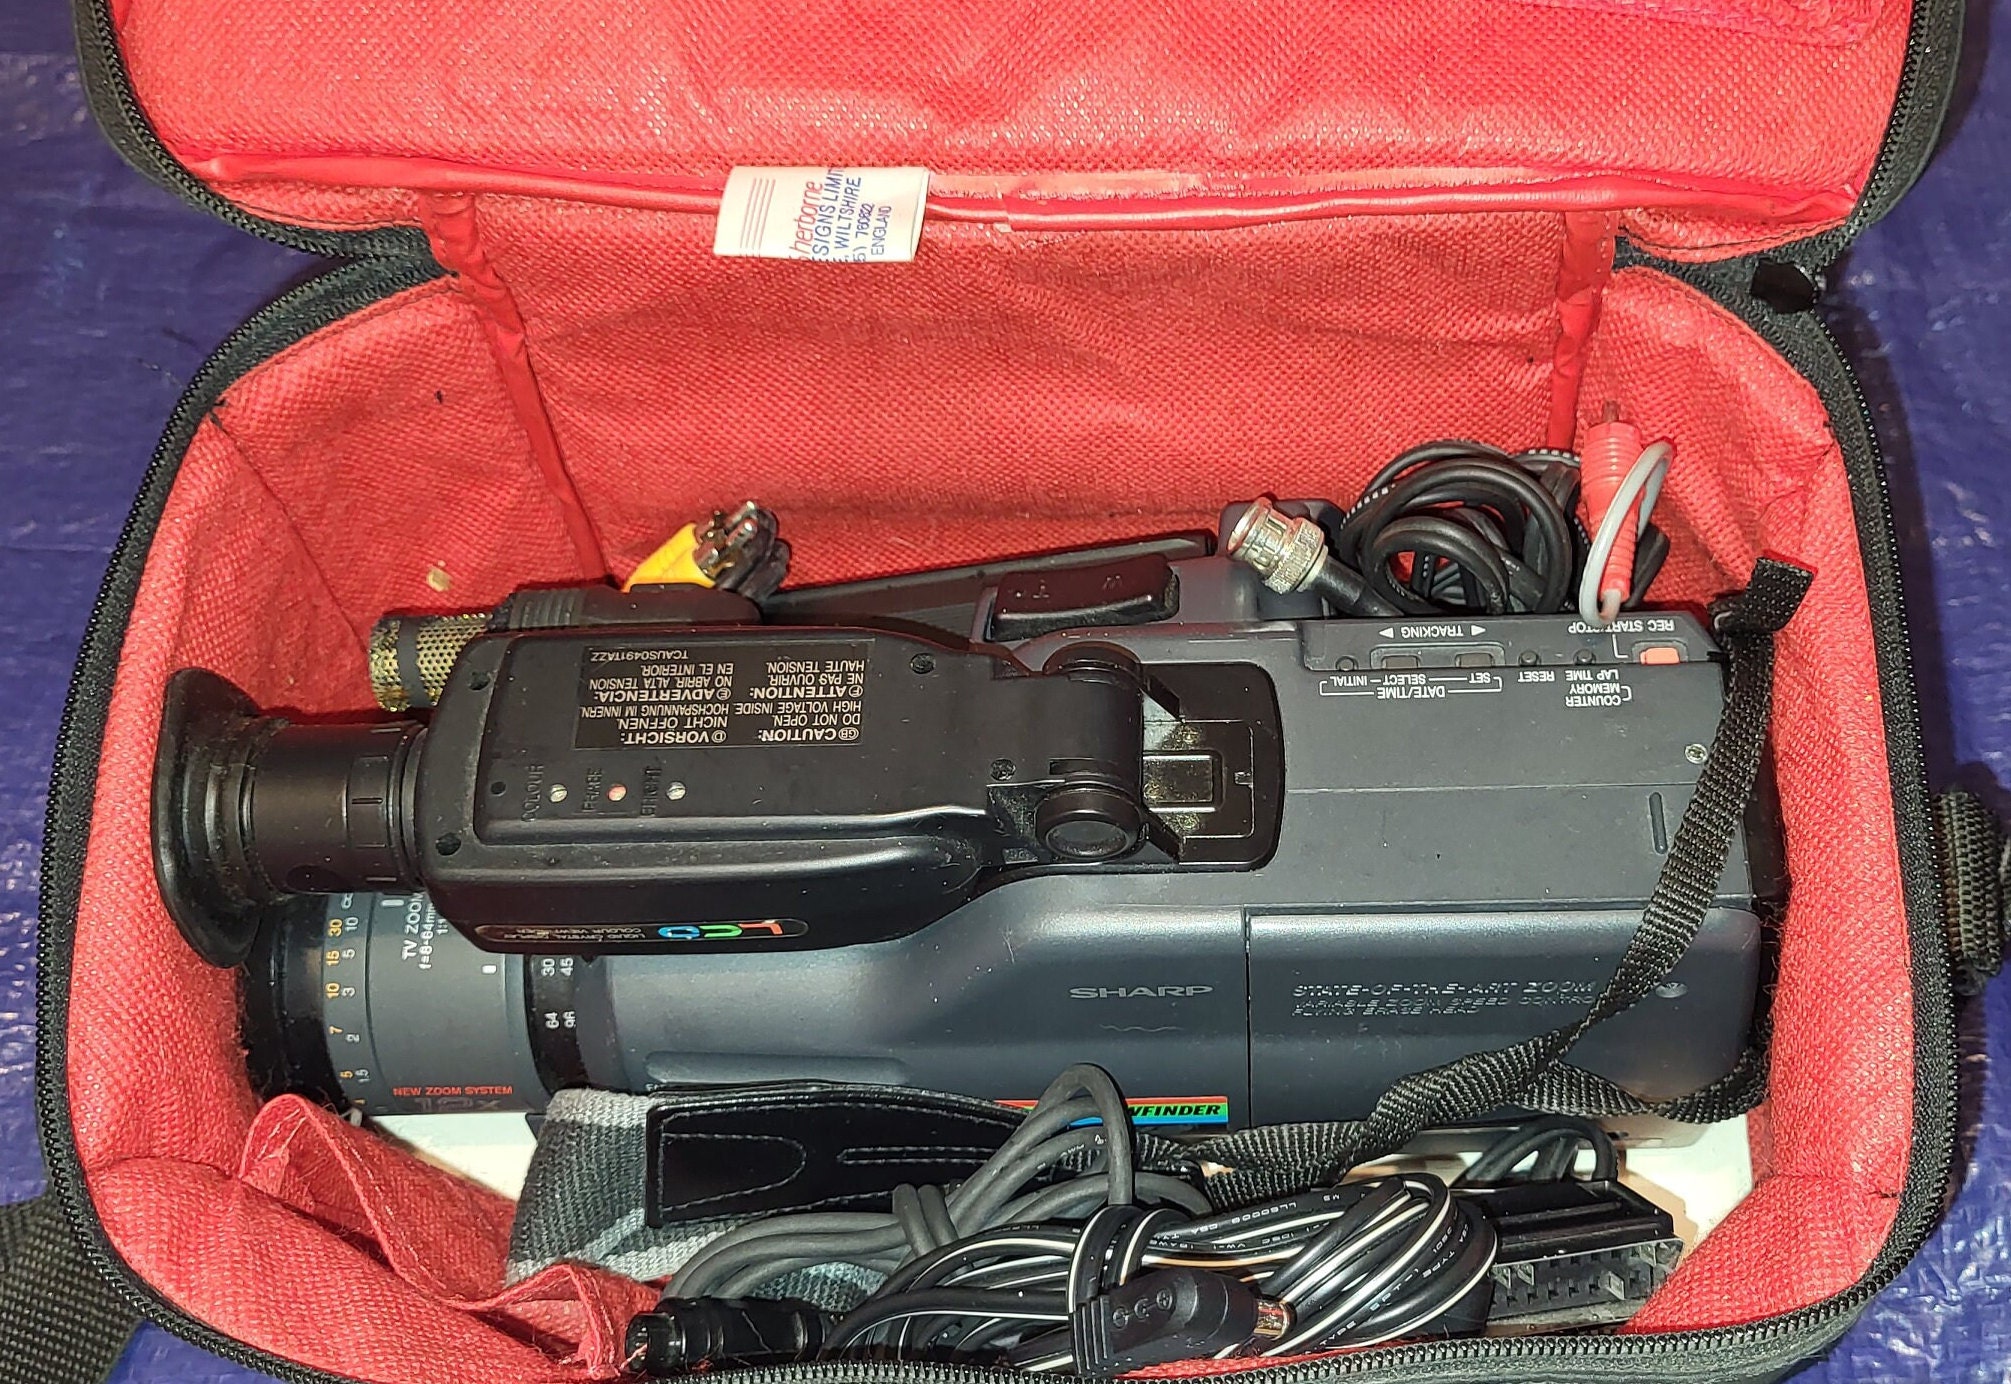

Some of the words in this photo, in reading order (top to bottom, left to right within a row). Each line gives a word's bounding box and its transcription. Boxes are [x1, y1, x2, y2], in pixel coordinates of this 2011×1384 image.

[834, 177, 861, 249] WILTSHIRE
[789, 181, 823, 261] herborne
[811, 206, 835, 263] SIGNS
[871, 206, 892, 255] ENGLAND
[1401, 624, 1463, 637] TRACKING
[1647, 619, 1674, 631] REC
[640, 664, 694, 676] INTERIOR.
[699, 663, 713, 674] EL
[718, 662, 734, 674] EN
[766, 661, 820, 672] TENSION.
[826, 660, 864, 672] HAUTE
[768, 674, 814, 685] OUVRIR.
[819, 673, 842, 684] PAS
[848, 672, 864, 683] NE
[1330, 675, 1367, 686] INITIAL
[1384, 674, 1426, 685] SELECT
[1469, 672, 1491, 683] SET
[1518, 671, 1554, 682] RESET
[1566, 670, 1592, 681] TIME
[1595, 669, 1619, 680] LAP
[589, 678, 638, 690] TENSION
[643, 677, 670, 688] ALTA
[675, 676, 710, 688] ABRIR.
[715, 676, 732, 687] NO
[594, 688, 714, 701] ADVERTENCIA:
[749, 686, 847, 698] ATTENTION:
[1377, 686, 1445, 698] DATE/TIME
[1570, 683, 1620, 694] MEMORY
[833, 700, 862, 712] HIGH
[1566, 695, 1621, 706] COUNTER
[580, 706, 622, 717] INNERN.
[625, 706, 637, 716] IM
[641, 703, 729, 716] HOCHSPANNUNG
[734, 702, 773, 714] INSIDE.
[778, 701, 828, 713] VOLTAGE
[684, 717, 728, 728] NICHT
[772, 714, 808, 726] OPEN.
[812, 714, 838, 725] NOT
[842, 713, 860, 724] DO
[616, 718, 678, 732] ÖFFNEN.
[620, 731, 709, 744] VORSICHT:
[758, 728, 836, 741] CAUTION:
[328, 918, 343, 937] 30
[346, 916, 359, 931] 10
[342, 948, 356, 959] 5
[402, 940, 417, 960] TV
[541, 958, 555, 976] 30
[560, 957, 574, 977] 45
[326, 982, 340, 998] 10
[342, 987, 356, 997] 3
[1068, 984, 1214, 1000] SHARP
[1522, 981, 1597, 993] ZOOM
[1519, 994, 1599, 1006] CONTRO
[544, 1012, 561, 1029] 64
[329, 1026, 343, 1035] 7
[346, 1034, 360, 1043] 2
[393, 1087, 421, 1096] NEW
[426, 1086, 462, 1095] ZOOM
[465, 1086, 513, 1095] SYSTEM
